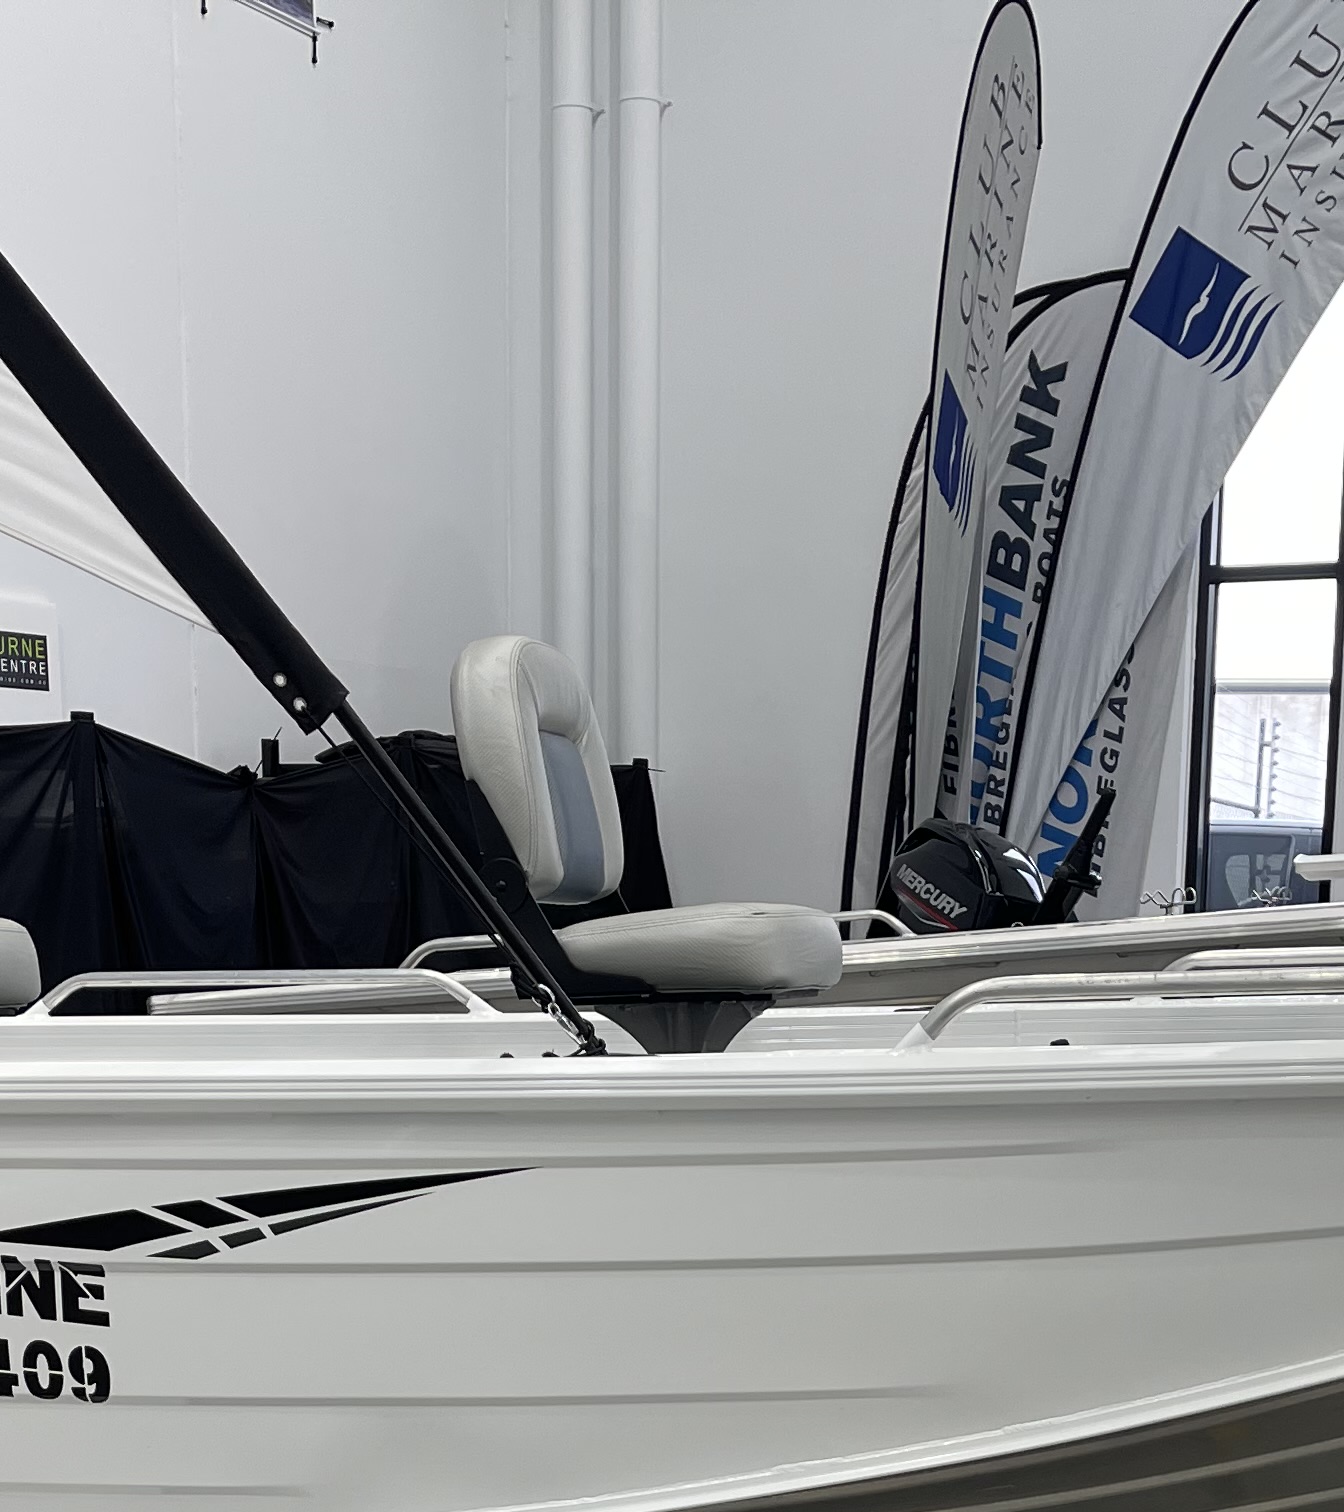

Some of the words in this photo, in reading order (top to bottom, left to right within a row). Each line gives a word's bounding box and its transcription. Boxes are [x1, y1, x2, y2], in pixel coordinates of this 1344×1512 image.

[959, 73, 1006, 326] CLUB
[965, 62, 1026, 392] MARINE
[976, 86, 1036, 411] INSURANCE
[896, 863, 968, 919] MERCURY
